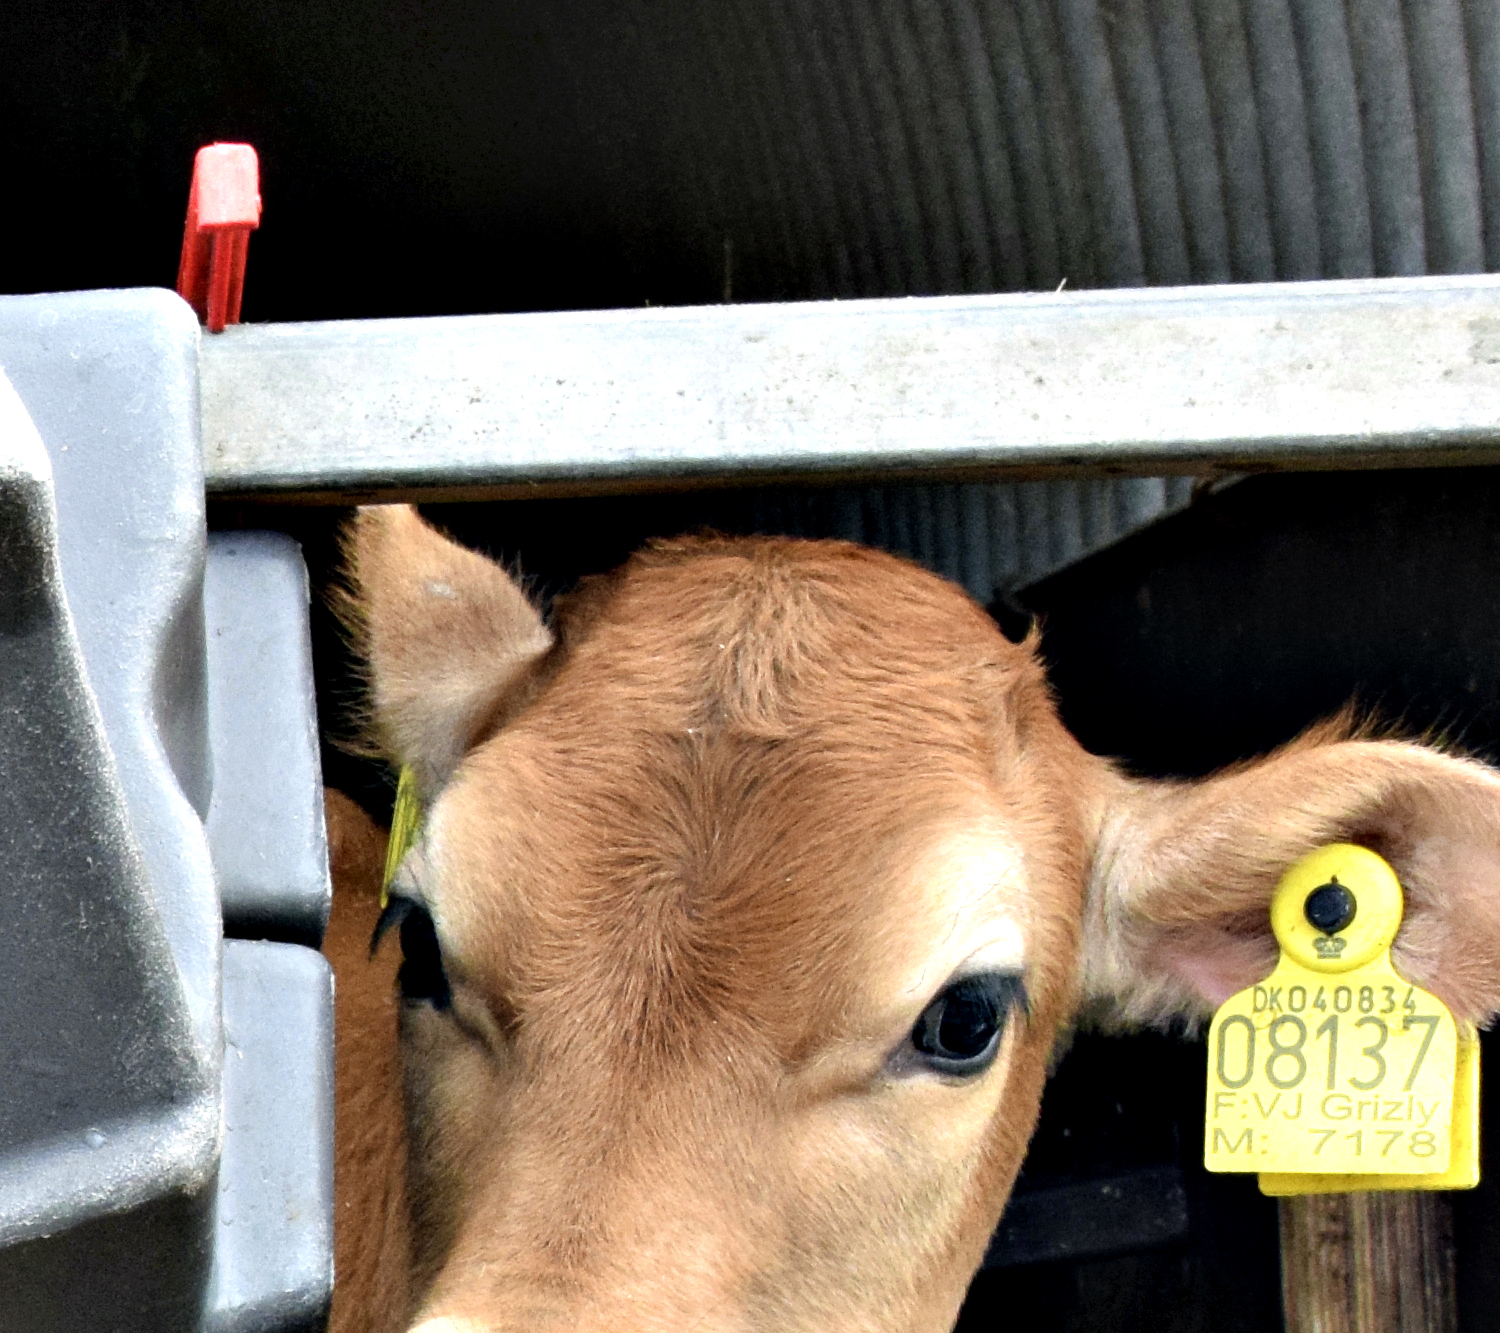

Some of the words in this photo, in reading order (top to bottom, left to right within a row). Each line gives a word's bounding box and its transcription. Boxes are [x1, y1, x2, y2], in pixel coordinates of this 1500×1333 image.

[1252, 985, 1417, 1014] DK040834
[1216, 1014, 1441, 1092] 08137
[1320, 1093, 1440, 1128] Grizly
[1212, 1127, 1269, 1156] M:
[1308, 1129, 1437, 1158] 7178
